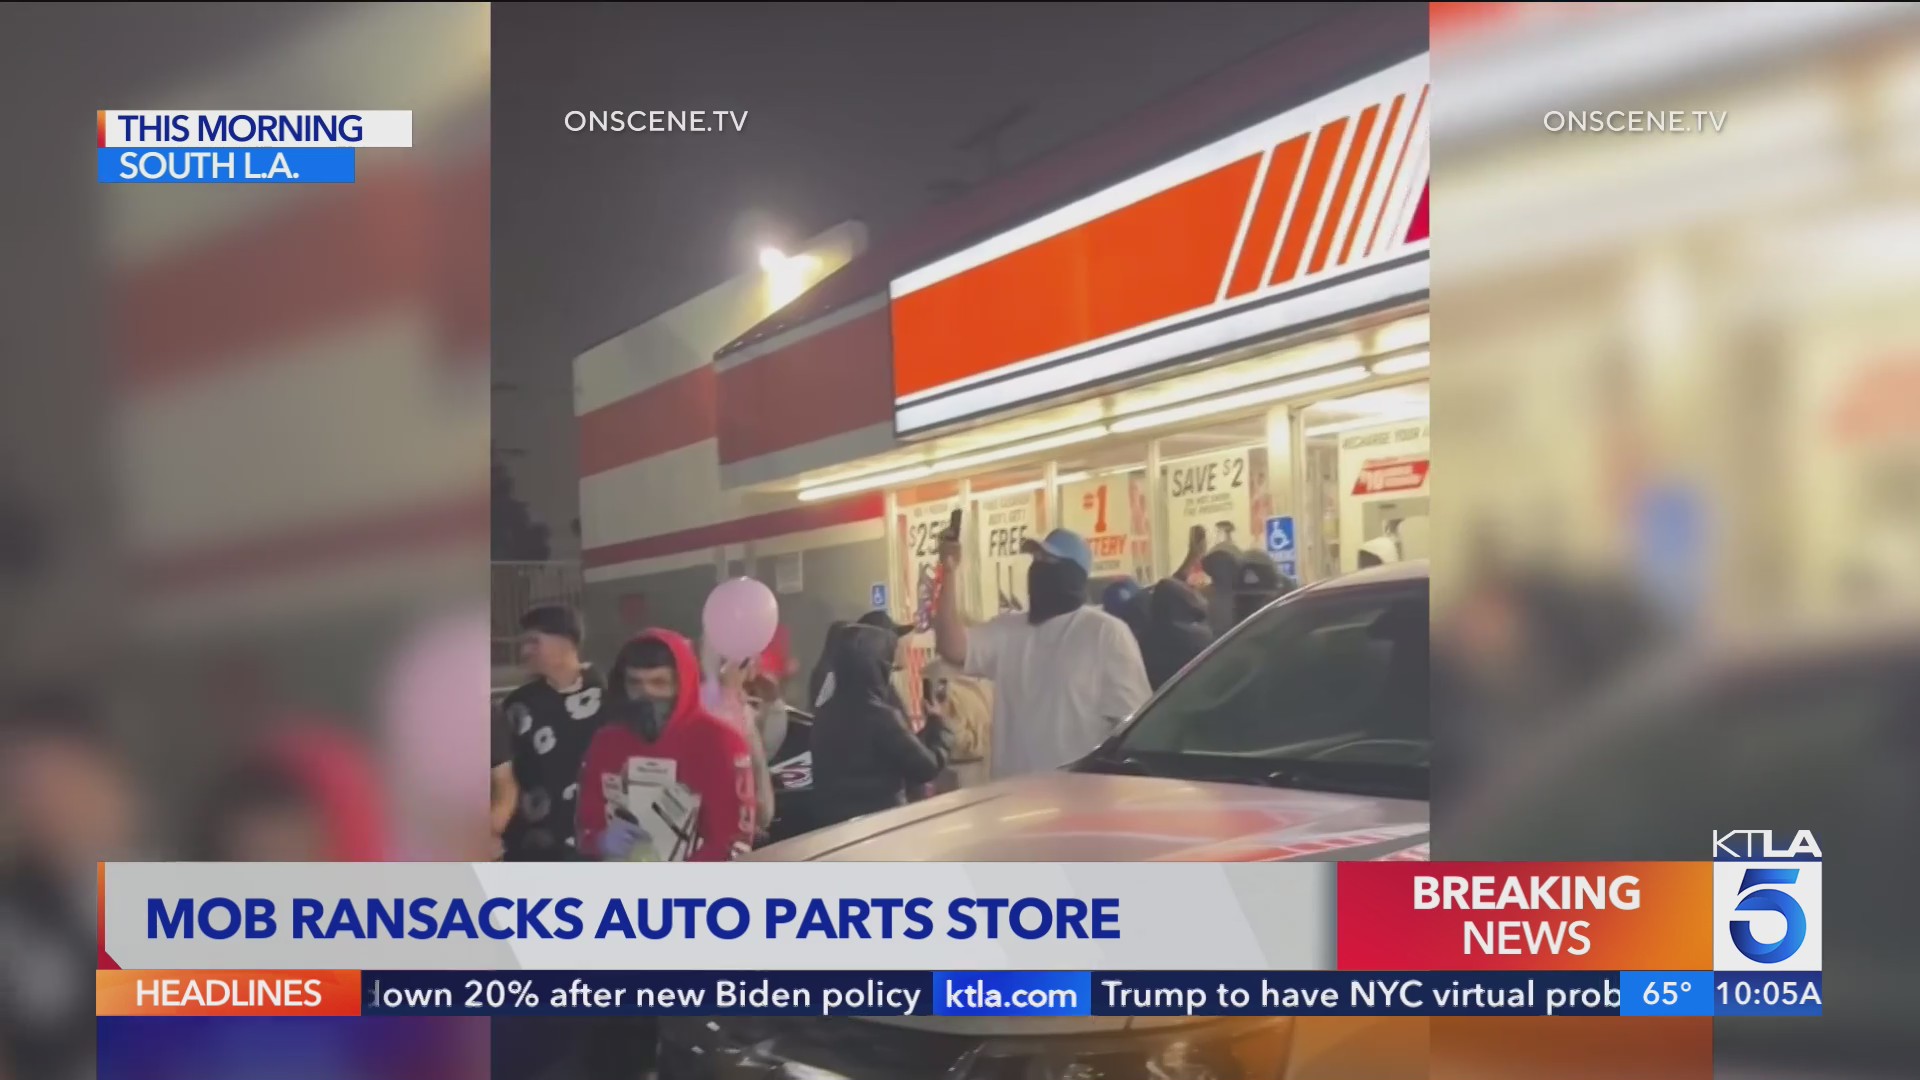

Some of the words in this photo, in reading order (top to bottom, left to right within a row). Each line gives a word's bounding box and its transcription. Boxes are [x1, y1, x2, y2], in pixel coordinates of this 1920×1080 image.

[1172, 462, 1218, 497] SAVE
[1223, 457, 1244, 488] $2
[1083, 484, 1107, 532] #1
[989, 525, 1028, 557] FREE
